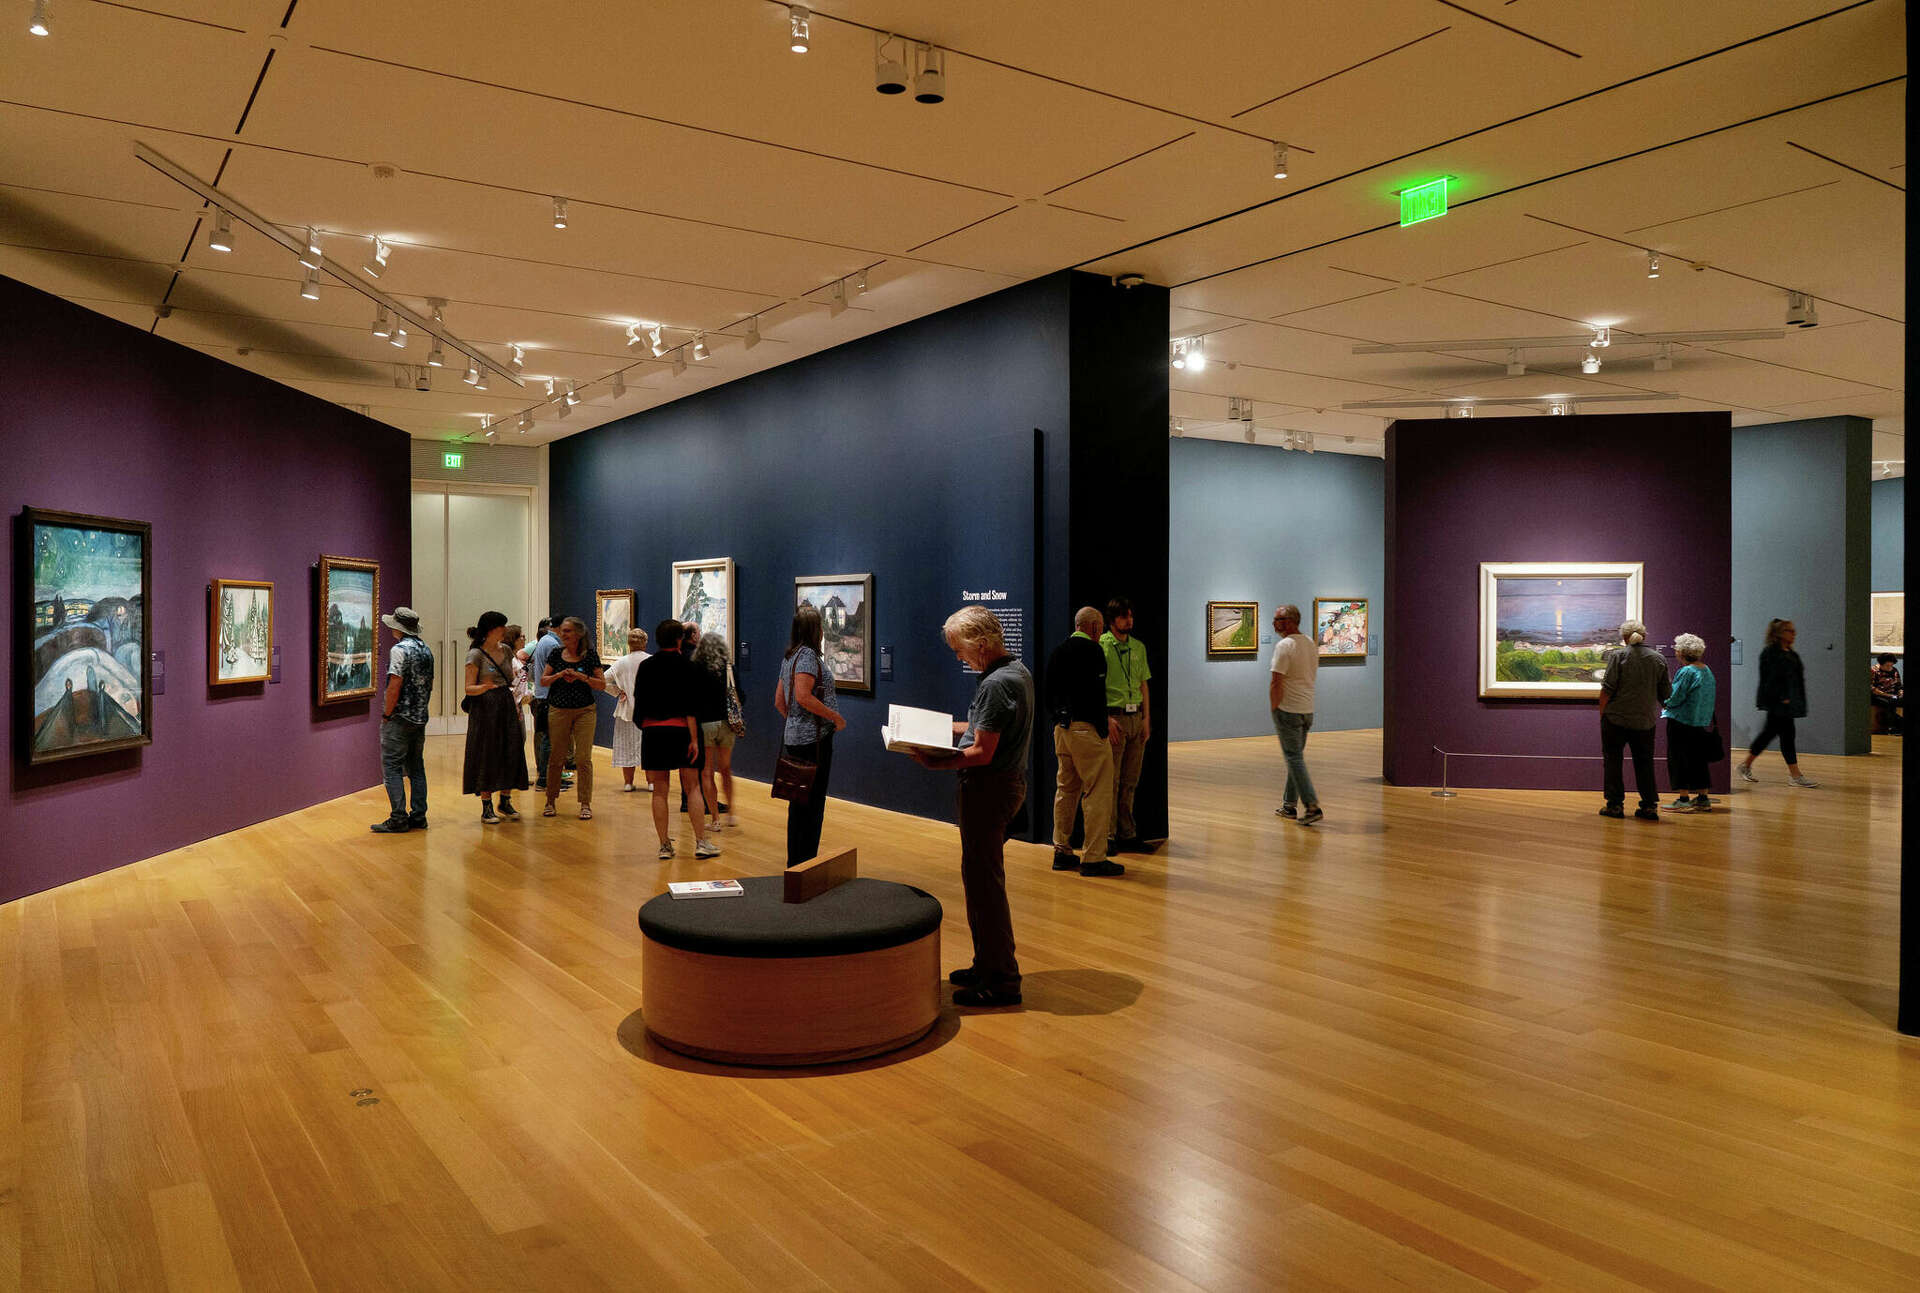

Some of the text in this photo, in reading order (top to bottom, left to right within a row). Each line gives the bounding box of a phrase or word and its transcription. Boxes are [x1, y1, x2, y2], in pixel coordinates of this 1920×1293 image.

[445, 455, 461, 467] EXIT
[962, 589, 1007, 601] Storm and Snow
